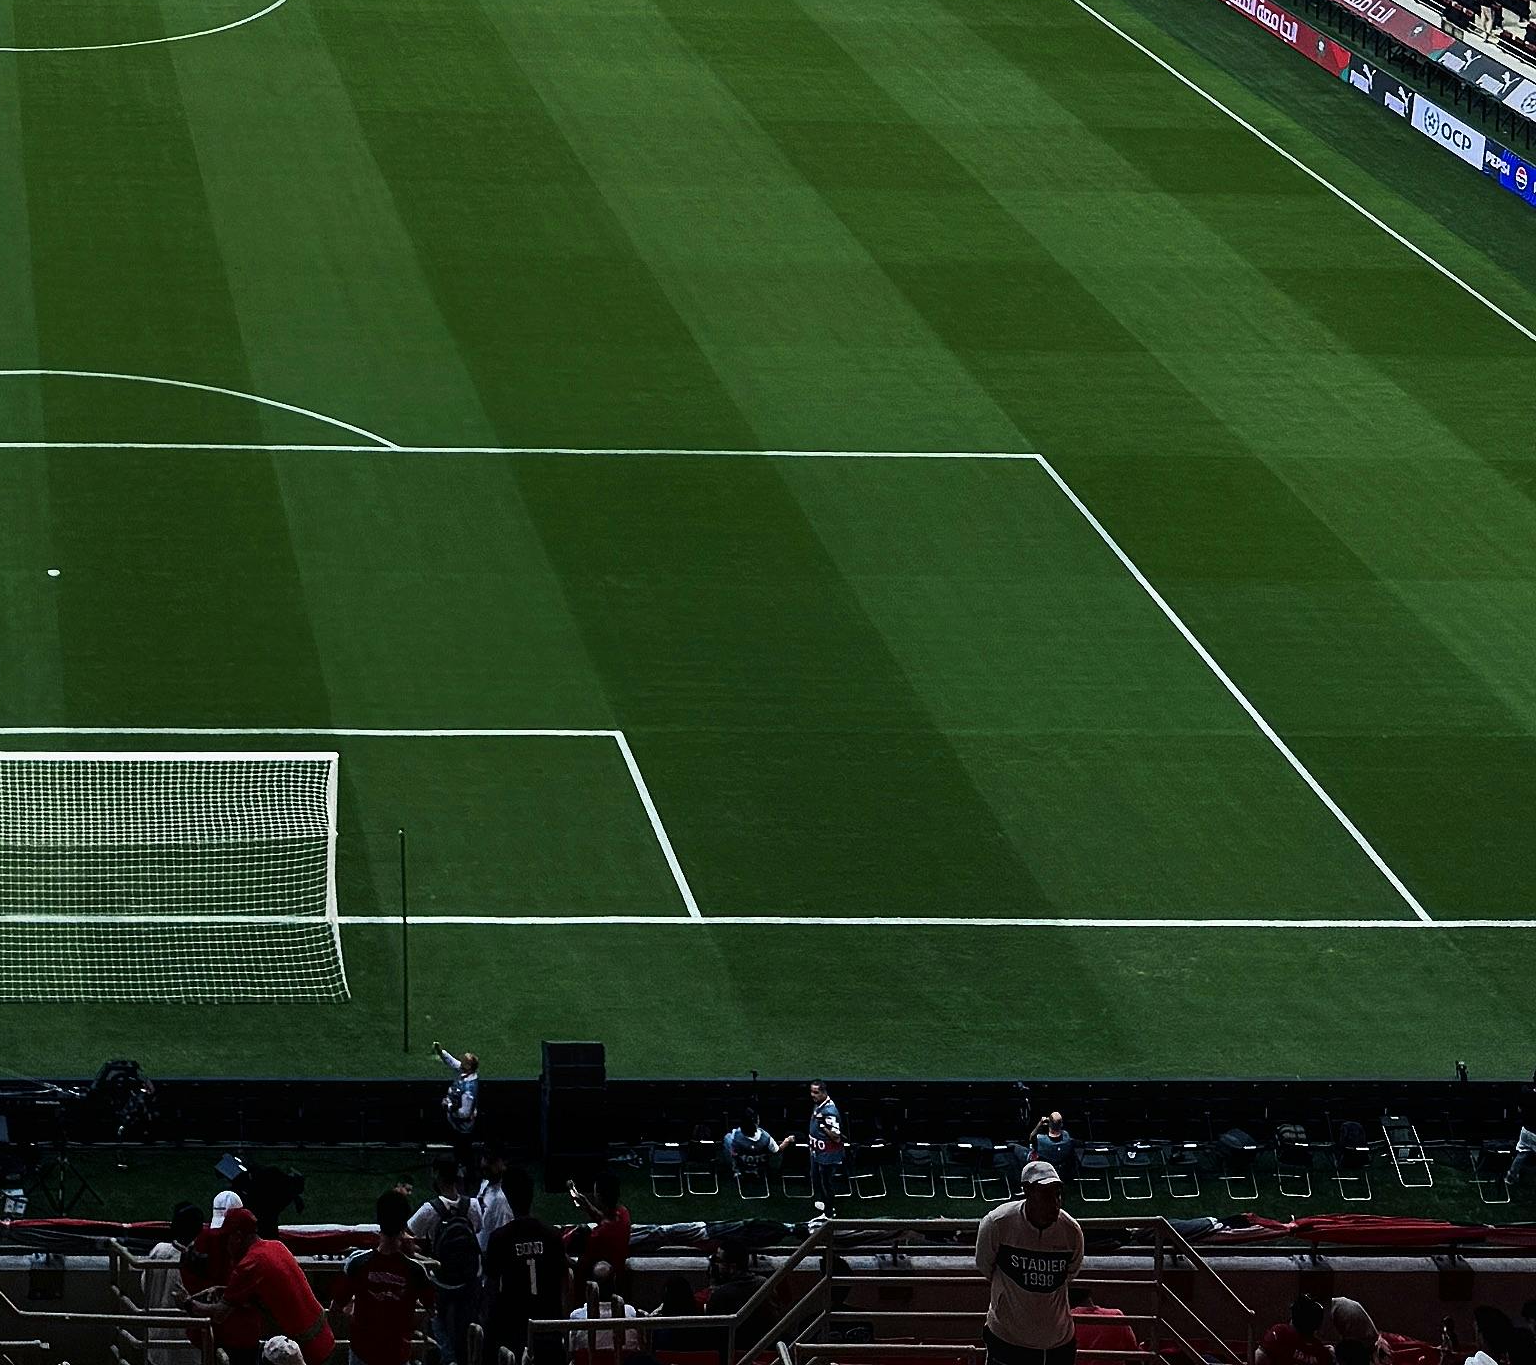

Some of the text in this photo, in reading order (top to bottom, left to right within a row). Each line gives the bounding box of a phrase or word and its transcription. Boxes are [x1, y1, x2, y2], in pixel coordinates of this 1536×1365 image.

[1442, 123, 1472, 150] OCP
[1486, 150, 1510, 176] PEPSI
[1010, 1255, 1067, 1272] STADIER
[526, 1259, 538, 1295] 1
